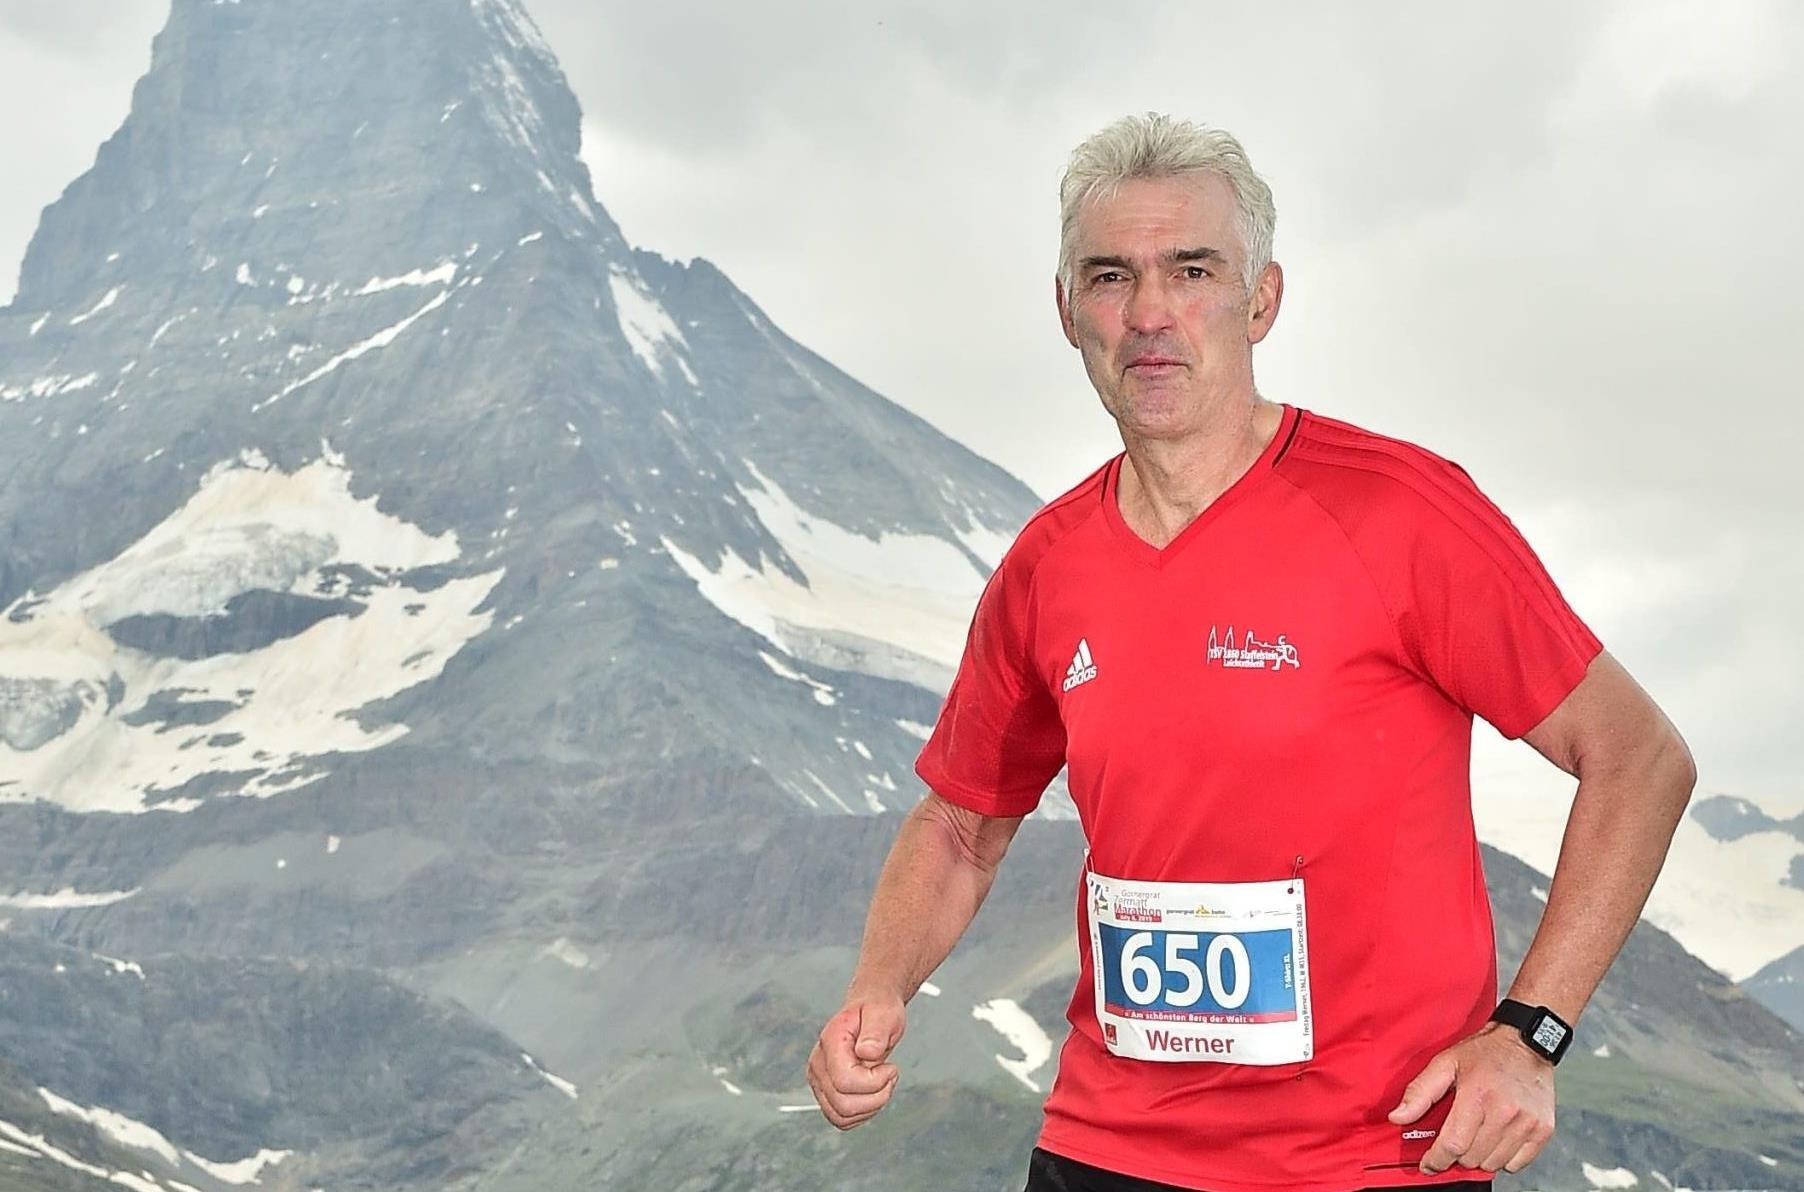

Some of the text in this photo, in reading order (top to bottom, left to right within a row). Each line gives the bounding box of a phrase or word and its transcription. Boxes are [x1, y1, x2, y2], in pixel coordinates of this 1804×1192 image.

[1062, 665, 1098, 692] adidas
[1113, 902, 1162, 917] Marathon
[1120, 931, 1251, 1010] 650
[1131, 1011, 1247, 1024] Am schönsten Berg der Welt
[1145, 1029, 1235, 1054] Werner
